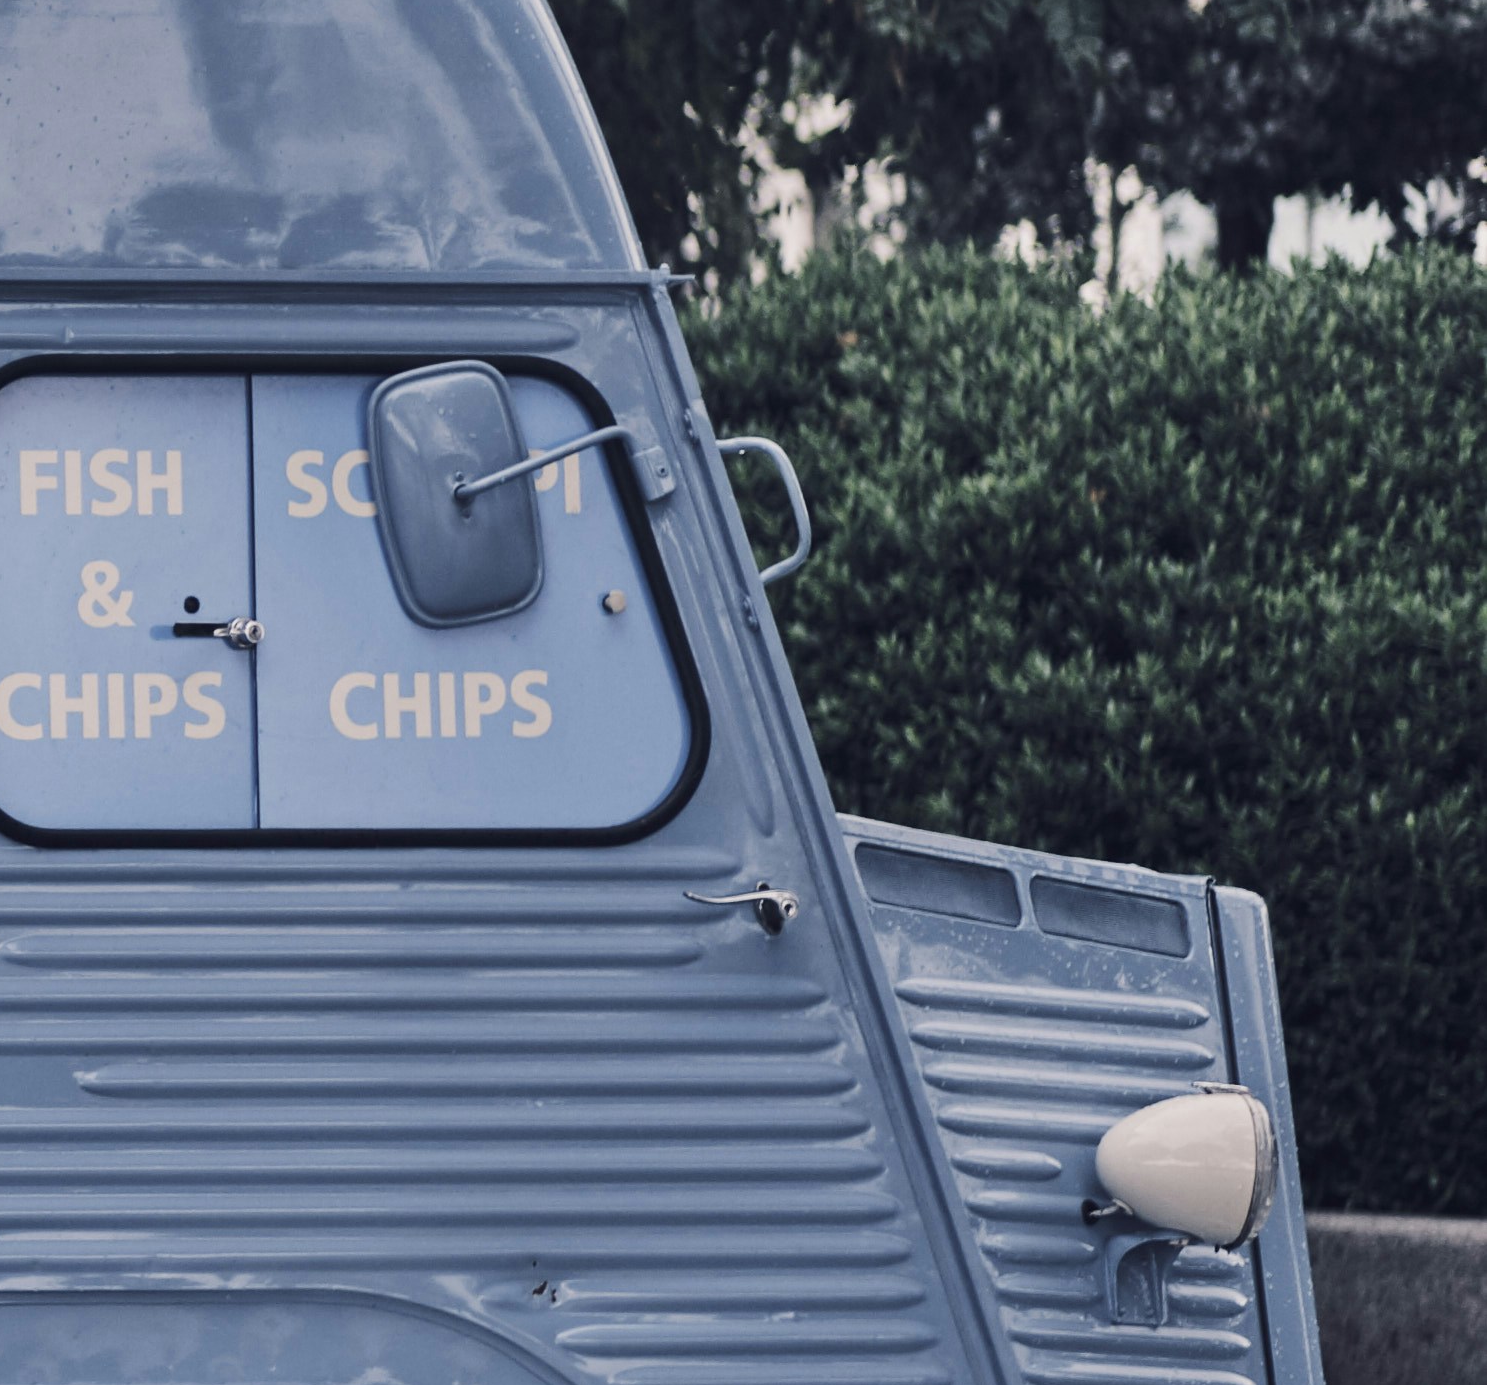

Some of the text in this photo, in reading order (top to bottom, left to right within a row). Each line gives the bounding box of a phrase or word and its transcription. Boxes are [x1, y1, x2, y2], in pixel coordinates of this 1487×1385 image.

[19, 449, 184, 517] FISH
[77, 560, 136, 628] &
[328, 669, 554, 740] CHIPS
